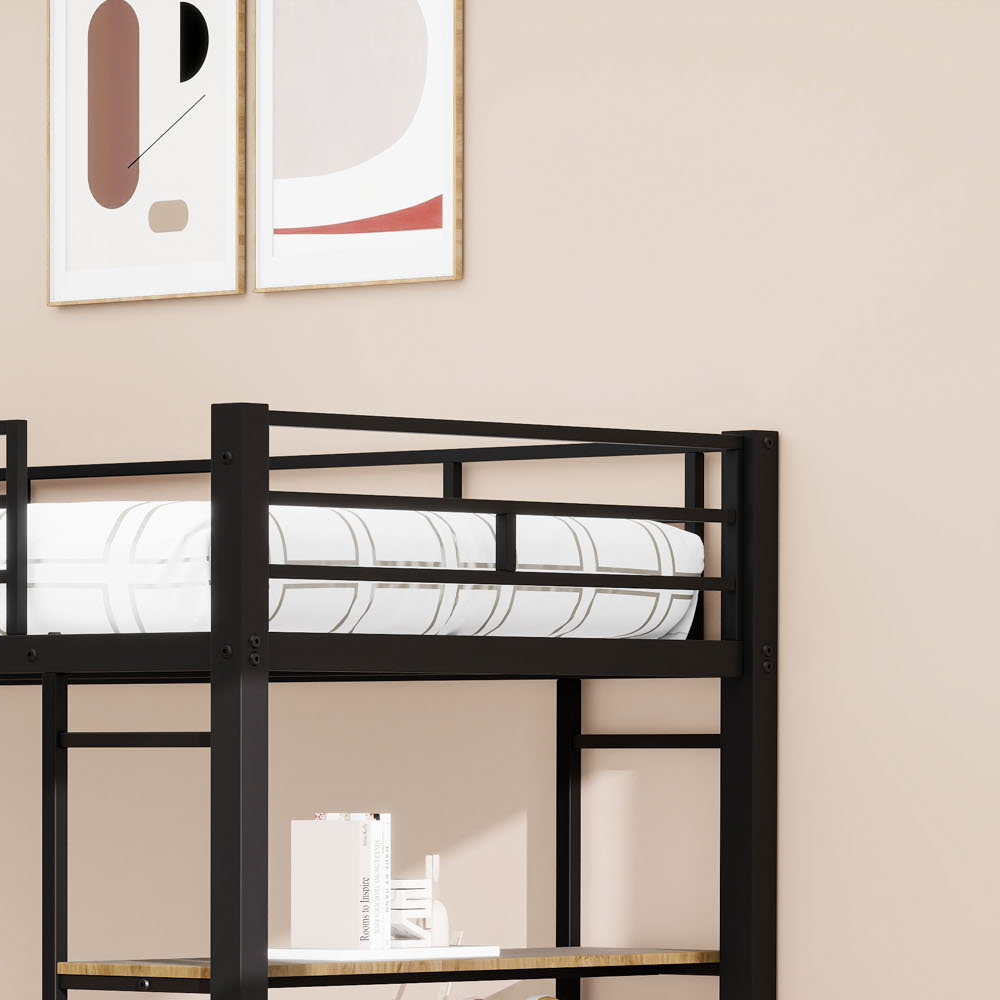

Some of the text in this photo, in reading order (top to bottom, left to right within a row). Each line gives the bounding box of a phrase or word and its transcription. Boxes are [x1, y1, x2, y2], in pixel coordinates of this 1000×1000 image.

[359, 876, 370, 941] Rooms to Inspire
